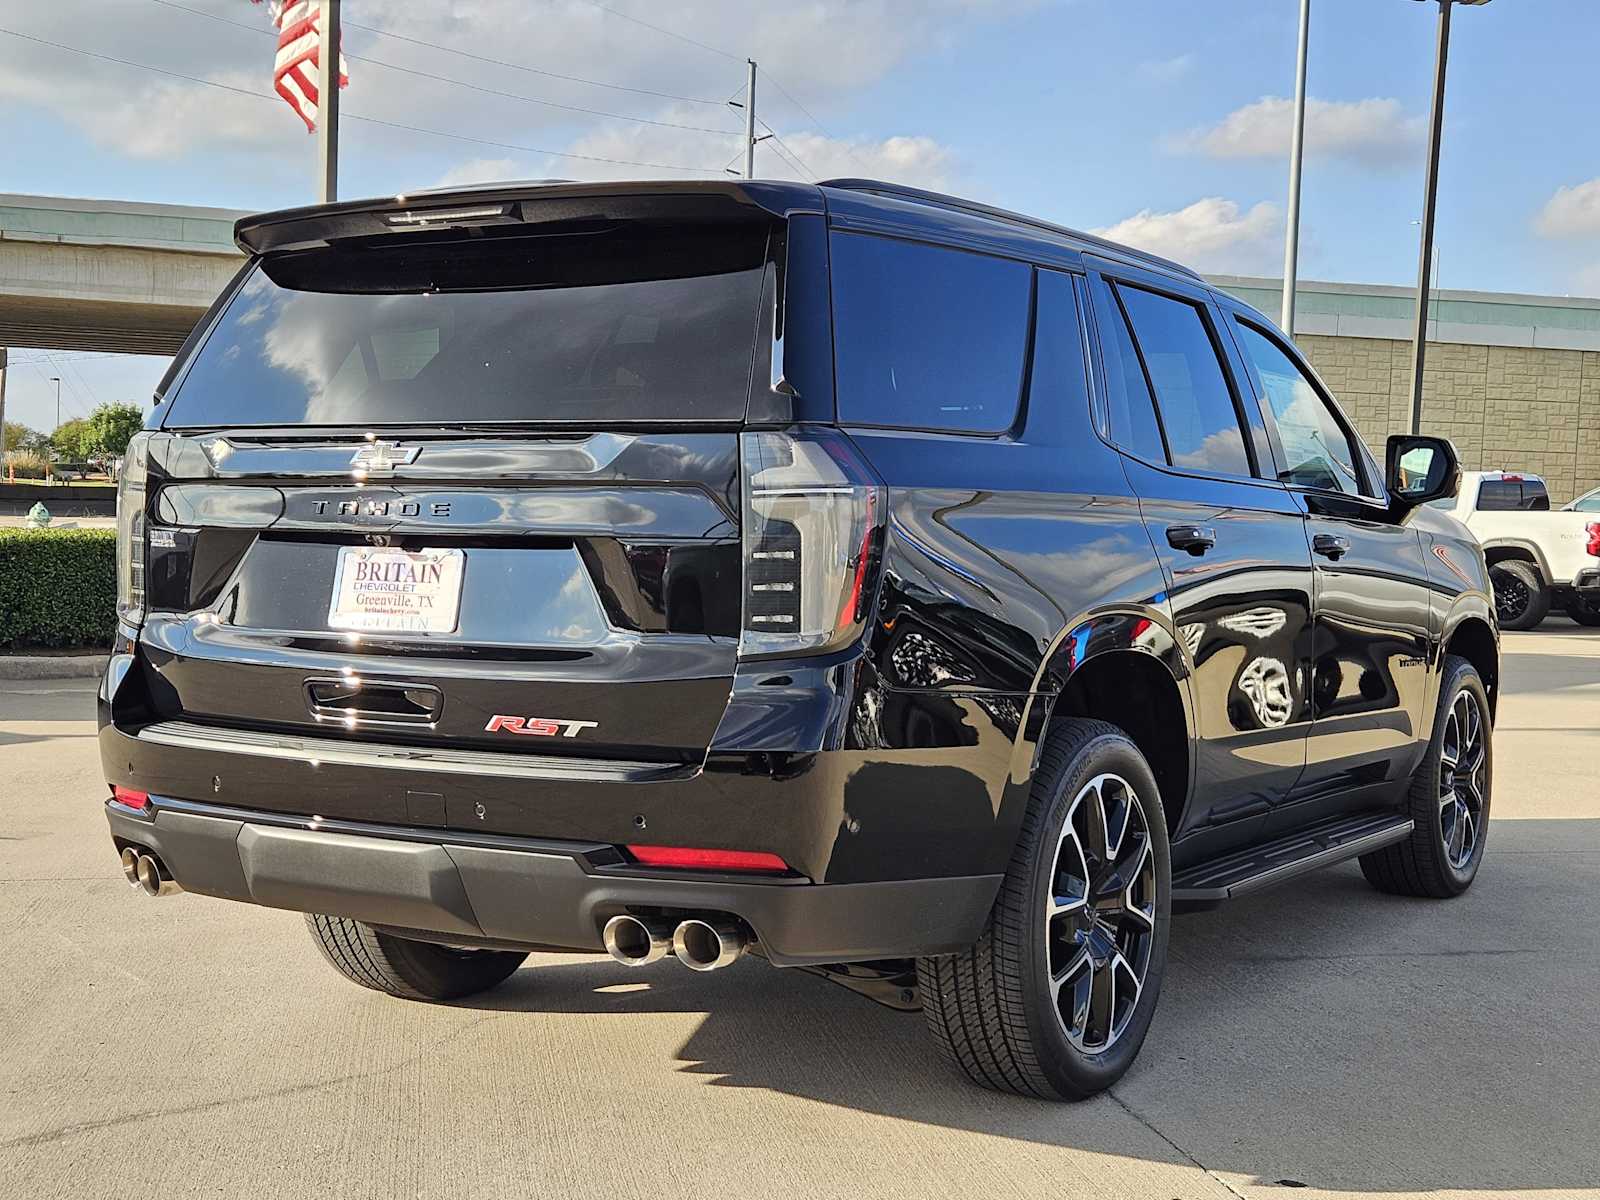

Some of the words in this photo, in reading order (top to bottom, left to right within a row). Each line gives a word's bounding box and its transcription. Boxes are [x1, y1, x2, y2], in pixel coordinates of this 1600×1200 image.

[311, 500, 452, 517] TAHOE
[355, 561, 443, 584] BRITAIN
[353, 582, 417, 592] CHEVROLET
[356, 593, 414, 608] Greenville,
[418, 595, 434, 608] TX
[484, 714, 599, 738] RST
